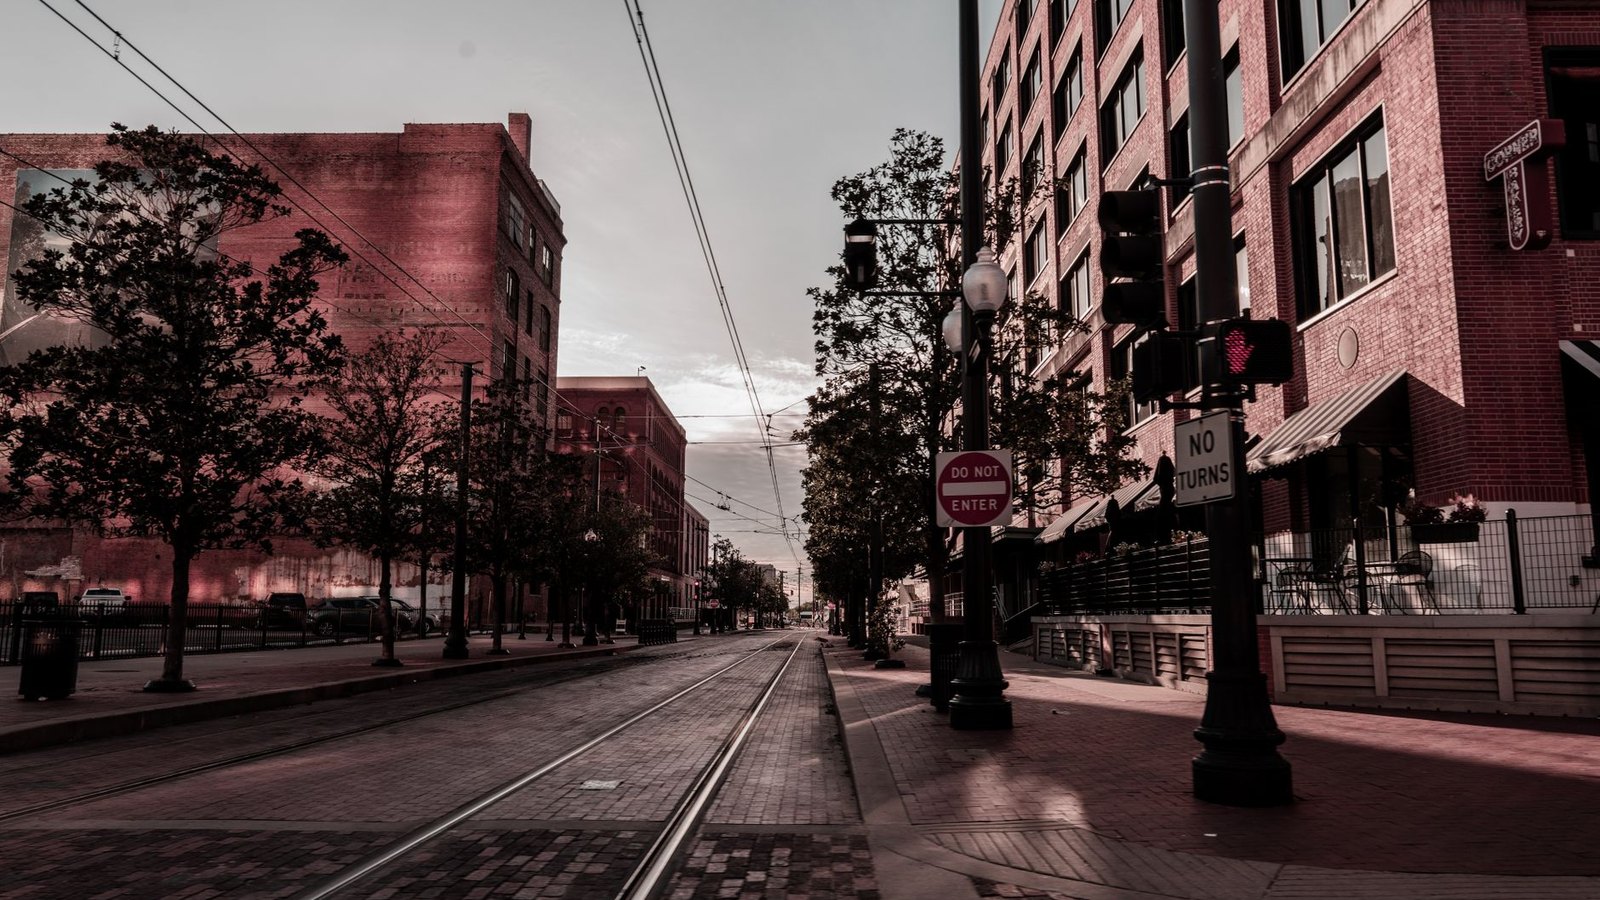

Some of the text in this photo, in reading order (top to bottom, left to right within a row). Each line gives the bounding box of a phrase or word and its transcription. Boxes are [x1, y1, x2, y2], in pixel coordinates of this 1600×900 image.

[1487, 128, 1538, 172] CORNER
[1508, 166, 1524, 239] BAKERY
[1189, 430, 1215, 457] NO
[951, 465, 999, 479] DO NOT
[1178, 462, 1229, 491] TURNS
[952, 499, 998, 511] ENTER
